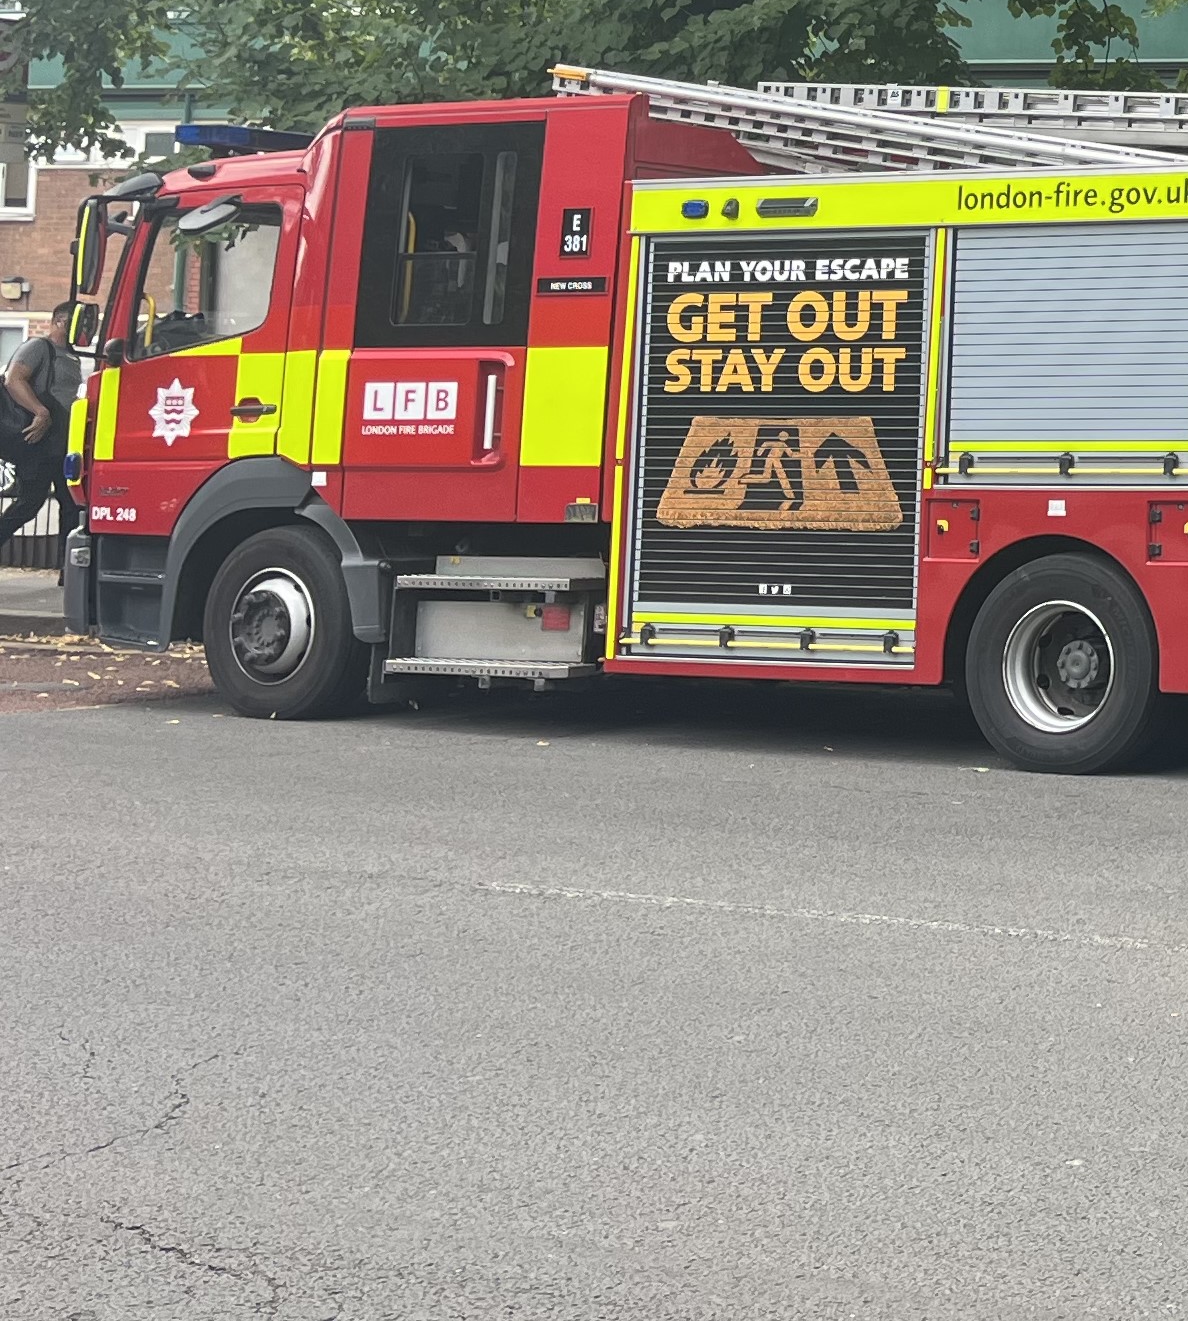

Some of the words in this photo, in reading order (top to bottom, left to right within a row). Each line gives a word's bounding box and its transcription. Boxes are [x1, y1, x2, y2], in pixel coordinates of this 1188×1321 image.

[572, 214, 582, 231] E
[563, 234, 587, 252] 381
[667, 260, 731, 283] PLAN
[739, 259, 806, 282] YOUR
[815, 257, 910, 280] ESCAPE
[550, 282, 567, 290] NEW
[567, 281, 593, 290] CROSS
[666, 292, 773, 343] GET
[786, 290, 909, 342] OUT
[663, 348, 787, 393] STAY
[797, 347, 907, 393] OUT
[361, 425, 397, 435] LONDON
[398, 425, 416, 435] FIRE
[417, 424, 455, 435] BRIGADE
[92, 506, 114, 520] DPL
[116, 507, 137, 522] 248
